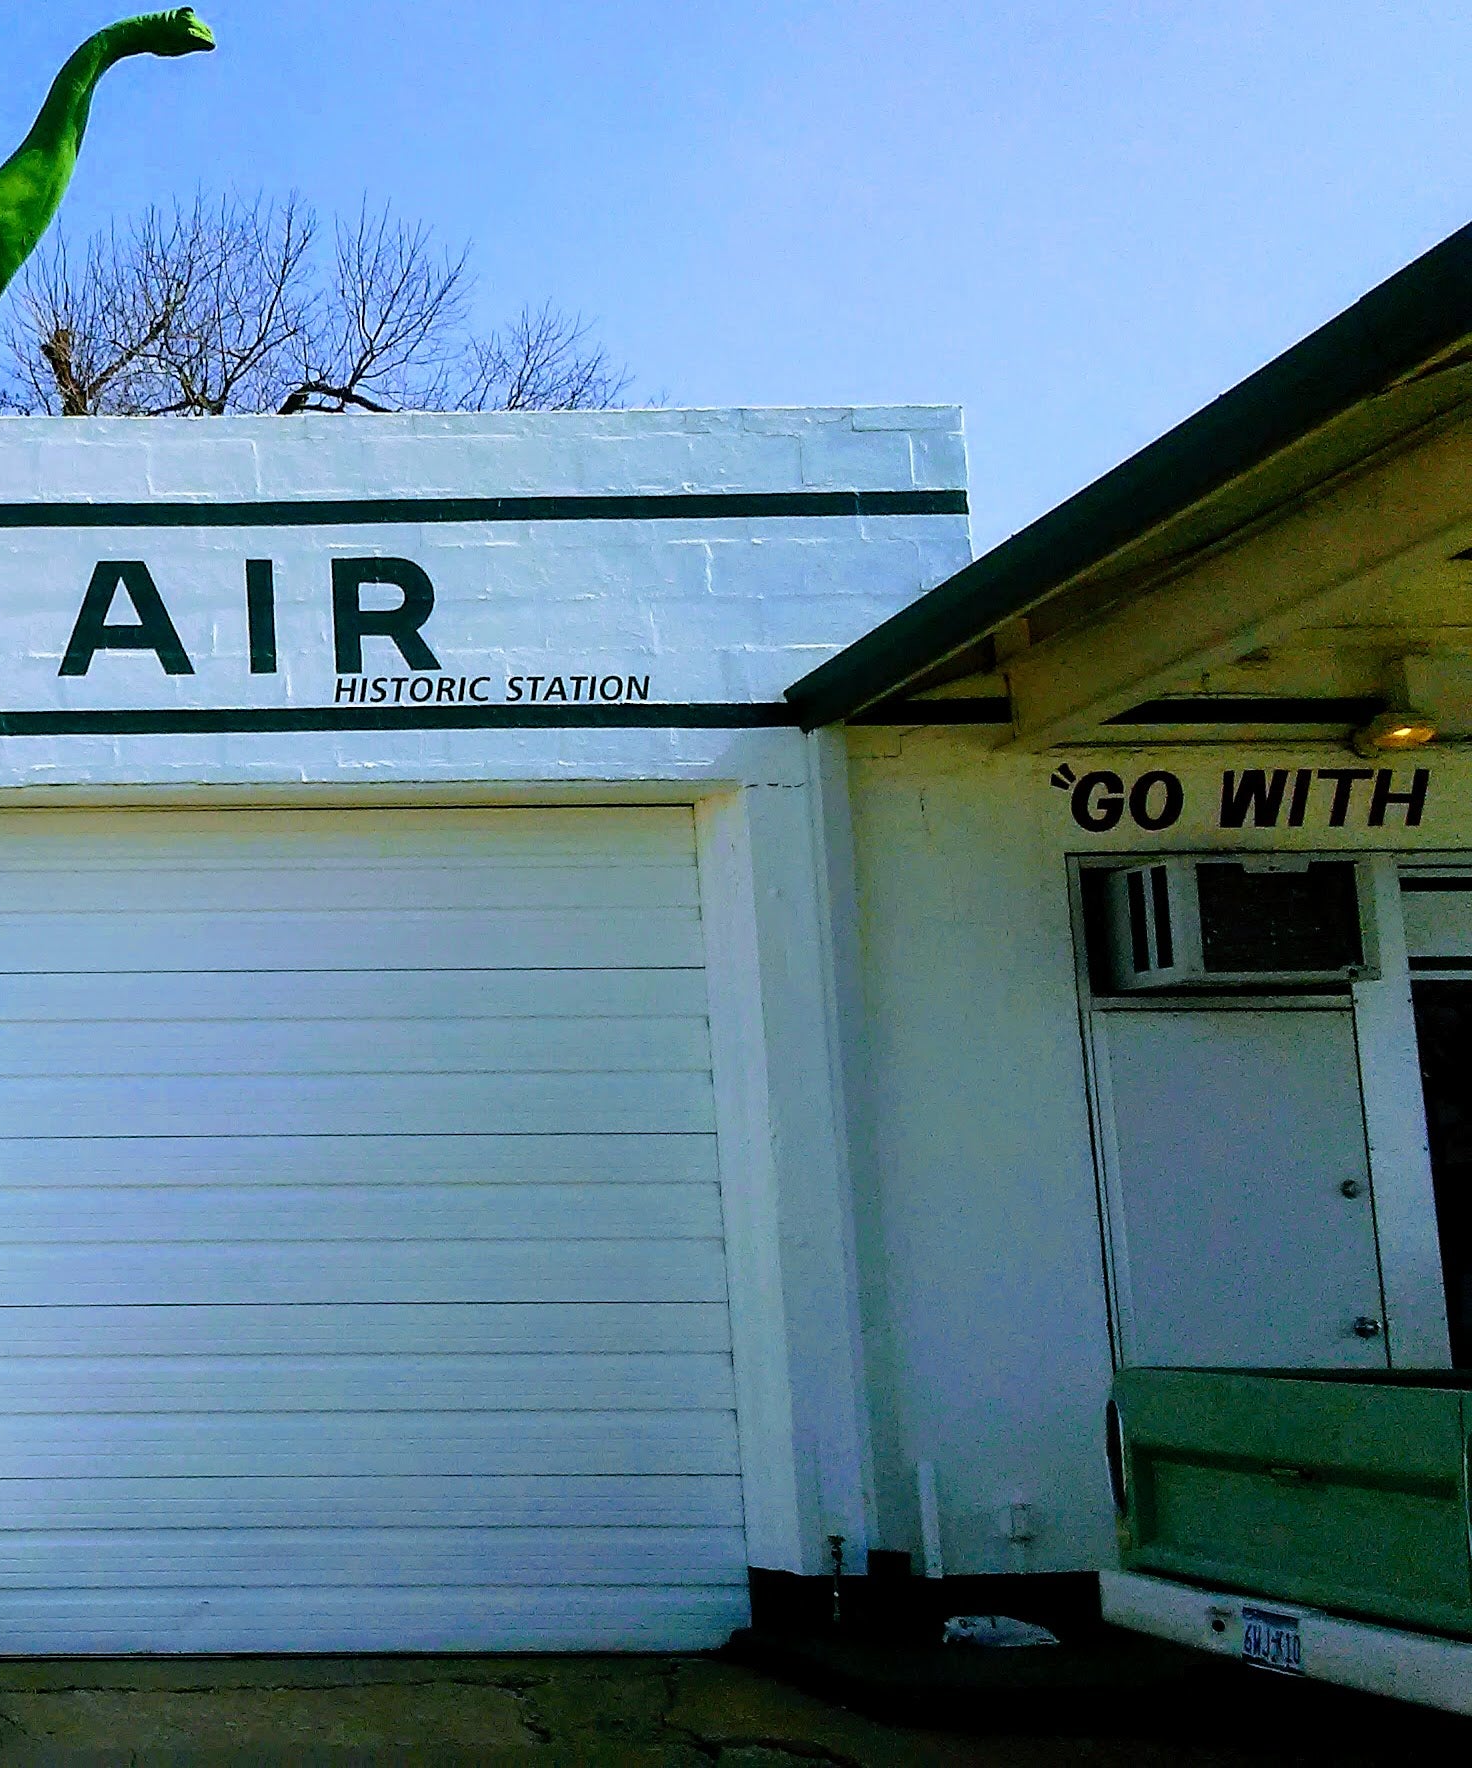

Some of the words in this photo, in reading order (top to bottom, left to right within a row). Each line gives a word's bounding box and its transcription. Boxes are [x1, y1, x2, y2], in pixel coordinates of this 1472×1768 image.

[334, 676, 491, 703] HISTORIC
[505, 675, 650, 702] STATION
[1219, 767, 1430, 829] WITH
